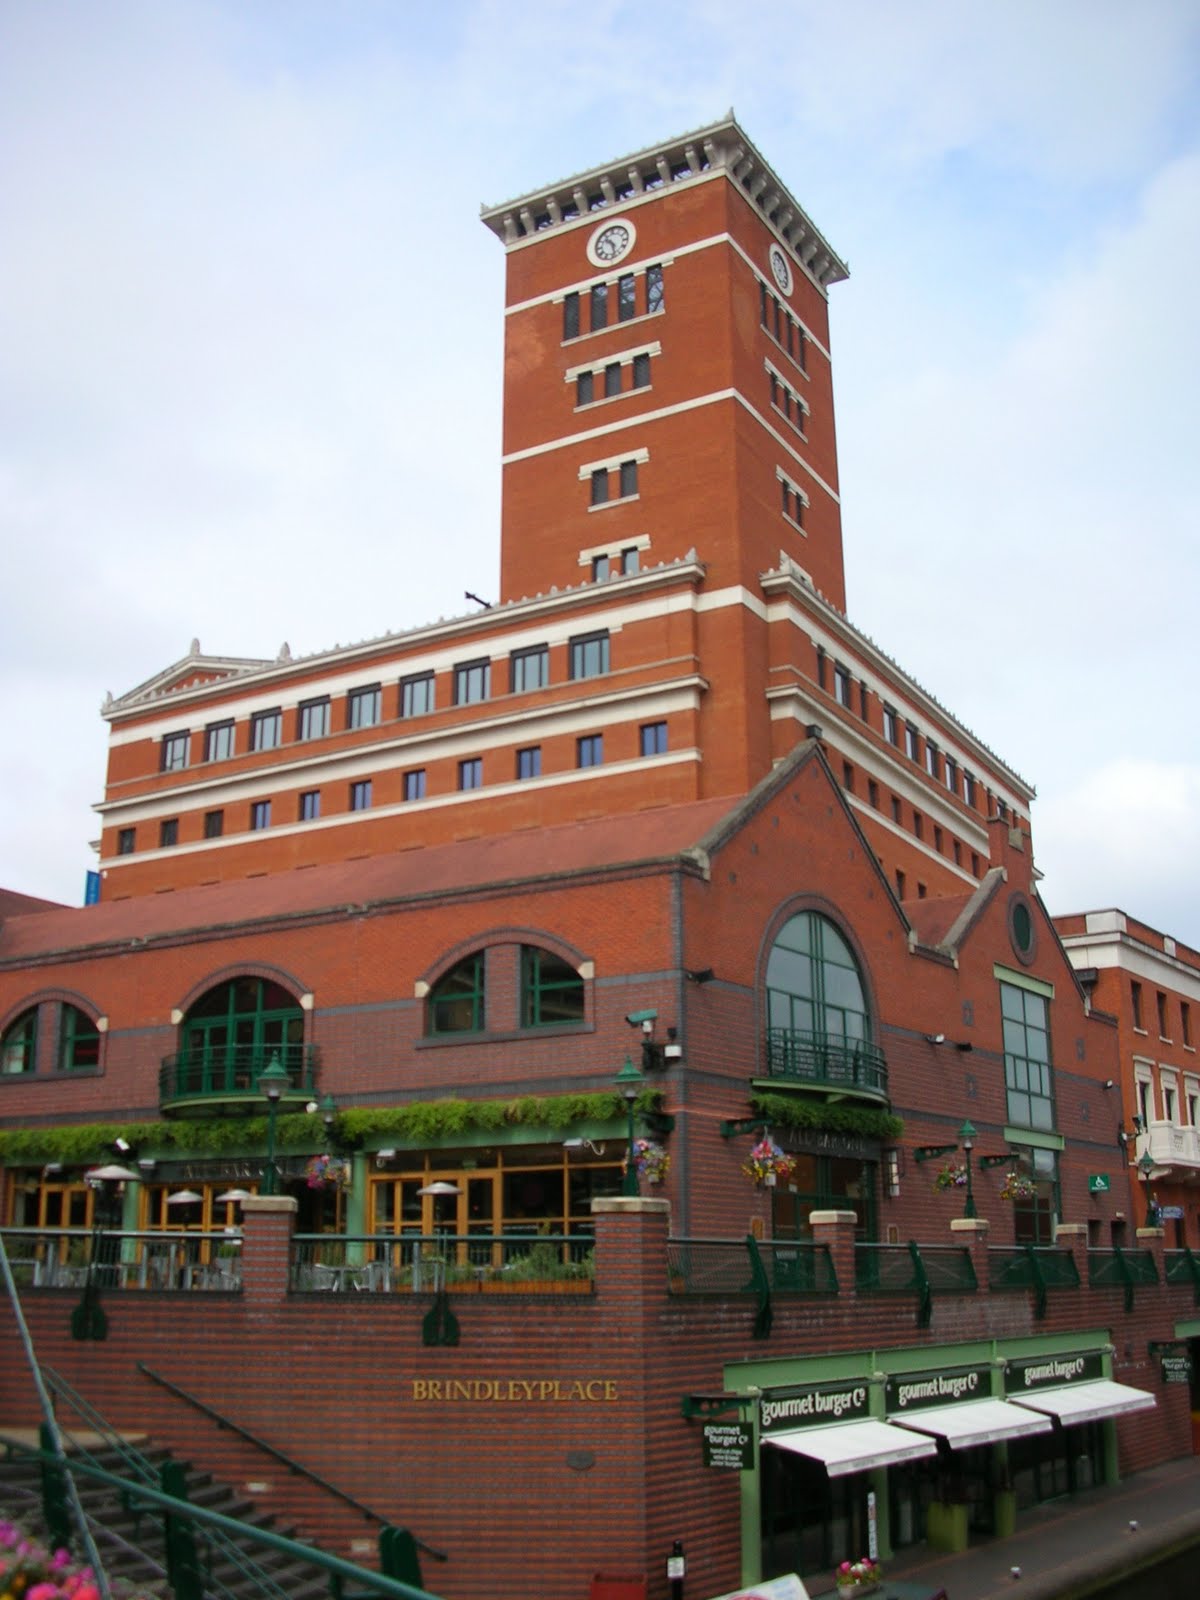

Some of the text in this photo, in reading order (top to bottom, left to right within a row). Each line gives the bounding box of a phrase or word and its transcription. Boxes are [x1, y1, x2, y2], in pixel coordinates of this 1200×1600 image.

[1025, 1362, 1054, 1386] gourmet
[1054, 1361, 1076, 1380] burger
[412, 1380, 619, 1401] BRINDLEYPLACE
[899, 1378, 938, 1406] gourmet
[939, 1376, 968, 1397] burger
[761, 1394, 814, 1426] gourmet
[815, 1392, 852, 1416] burger
[704, 1426, 740, 1436] gourmet
[709, 1435, 738, 1446] burger
